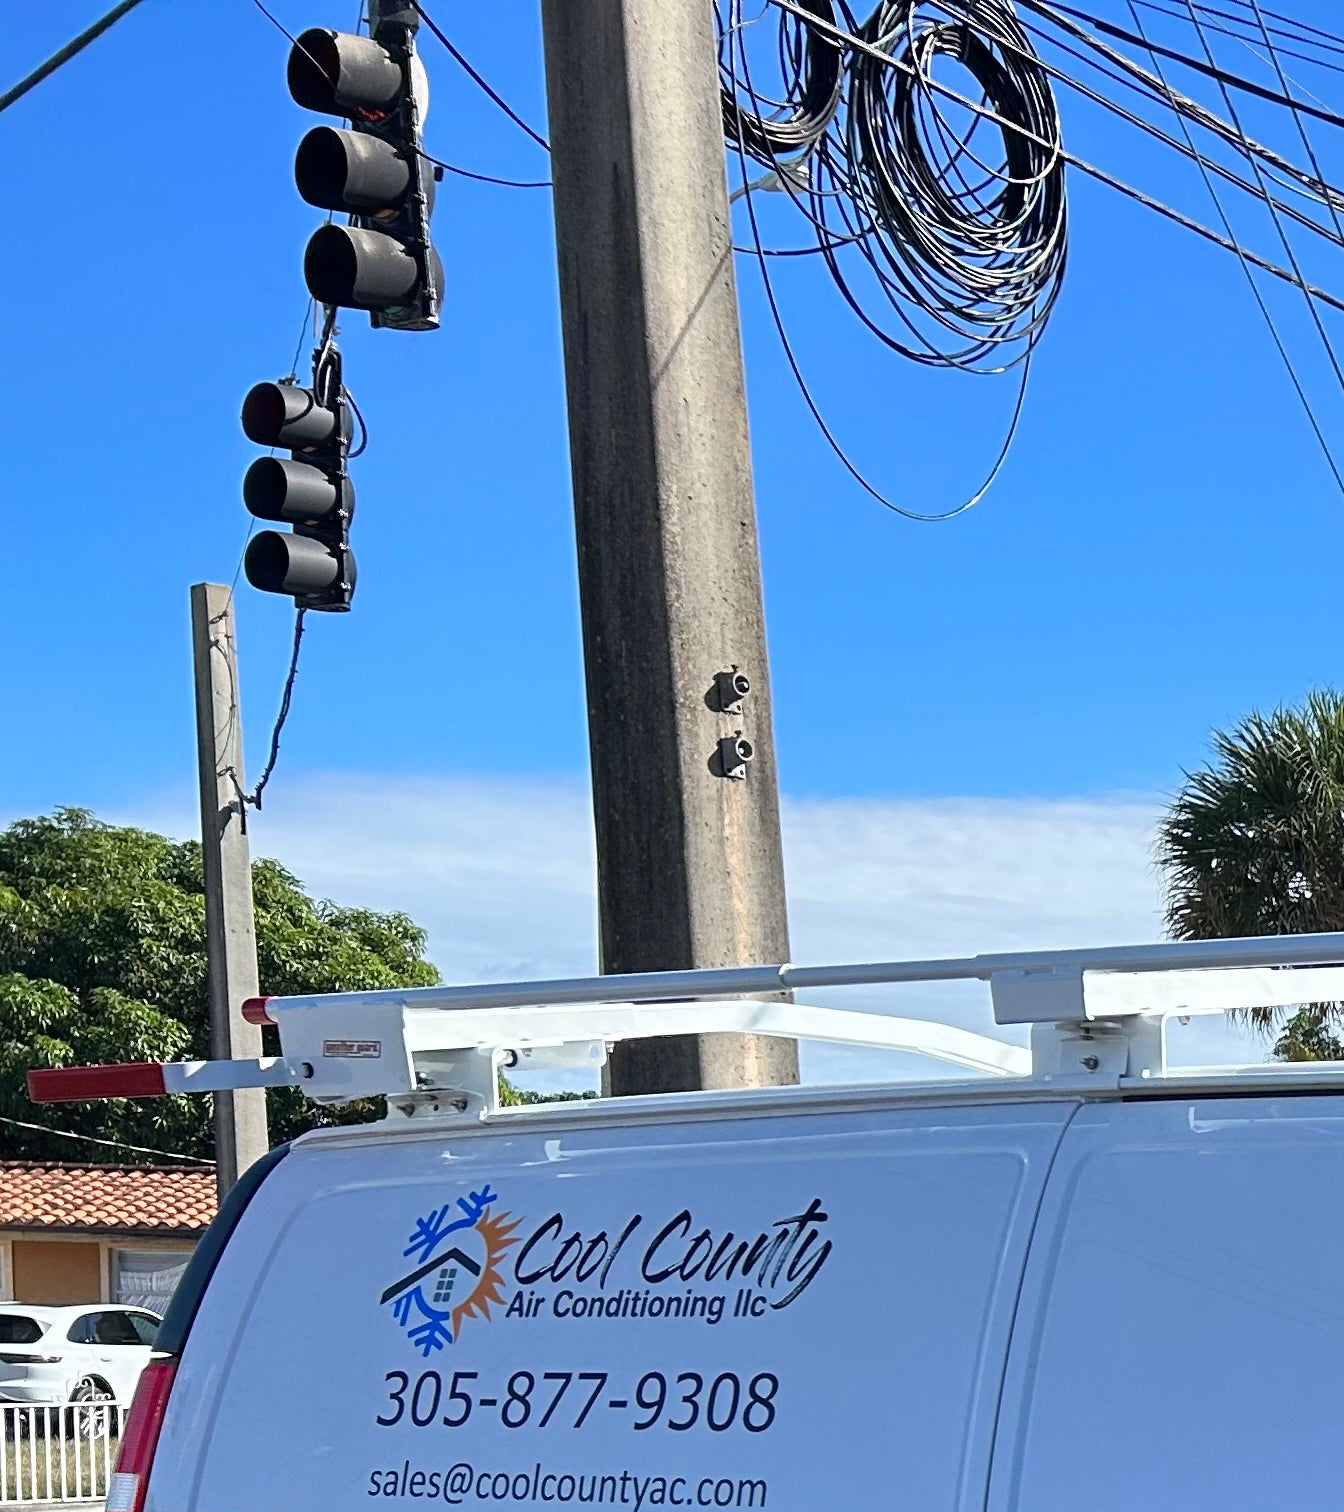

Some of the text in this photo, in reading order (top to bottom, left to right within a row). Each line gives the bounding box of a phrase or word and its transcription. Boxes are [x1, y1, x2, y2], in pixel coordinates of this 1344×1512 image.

[513, 1197, 834, 1311] Cool County
[505, 1289, 546, 1319] Air
[552, 1288, 726, 1325] Conditioning
[376, 1369, 780, 1433] 305-877-9308
